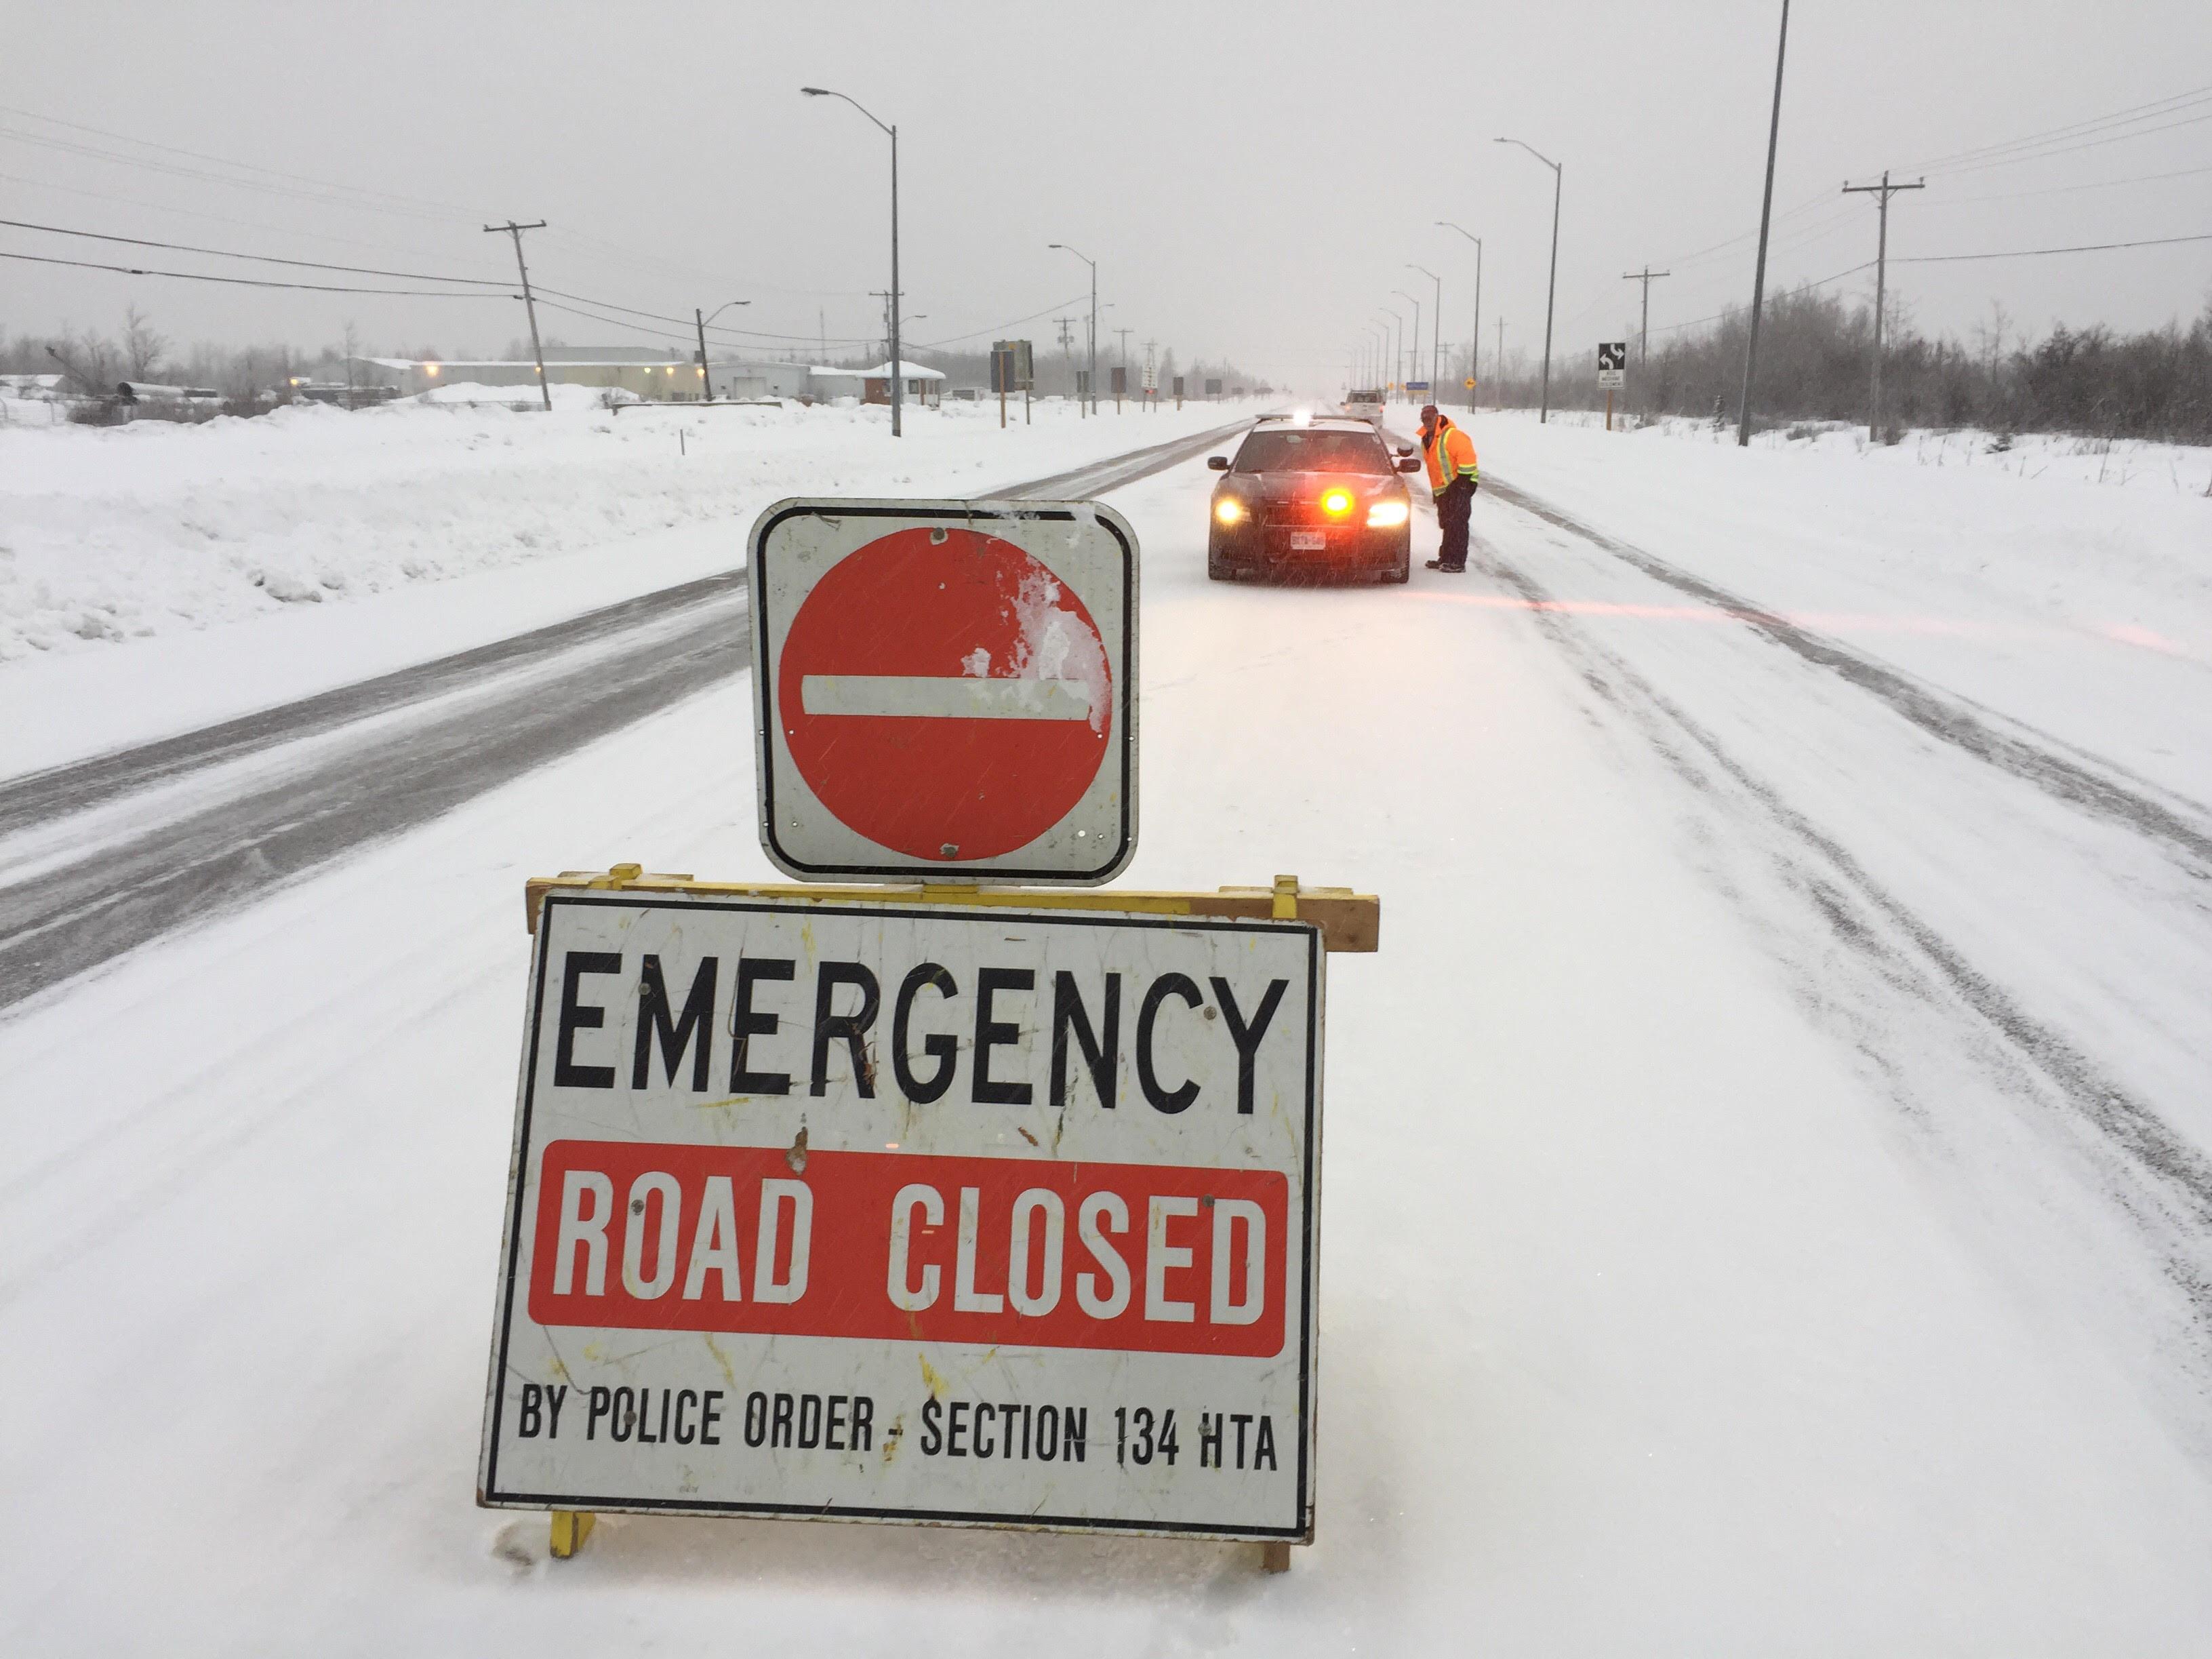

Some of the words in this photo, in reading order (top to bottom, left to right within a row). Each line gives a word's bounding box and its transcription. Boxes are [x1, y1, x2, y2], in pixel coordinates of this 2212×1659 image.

[554, 951, 1289, 1115] EMERGENCY
[554, 1171, 813, 1303] ROAD
[887, 1184, 1266, 1325] CLOSED
[519, 1384, 567, 1439] BY
[586, 1386, 724, 1445] POLICE
[744, 1391, 873, 1451] ORDER
[921, 1399, 1087, 1462] SECTION
[1114, 1407, 1180, 1465] 134
[1198, 1412, 1277, 1471] HTA
